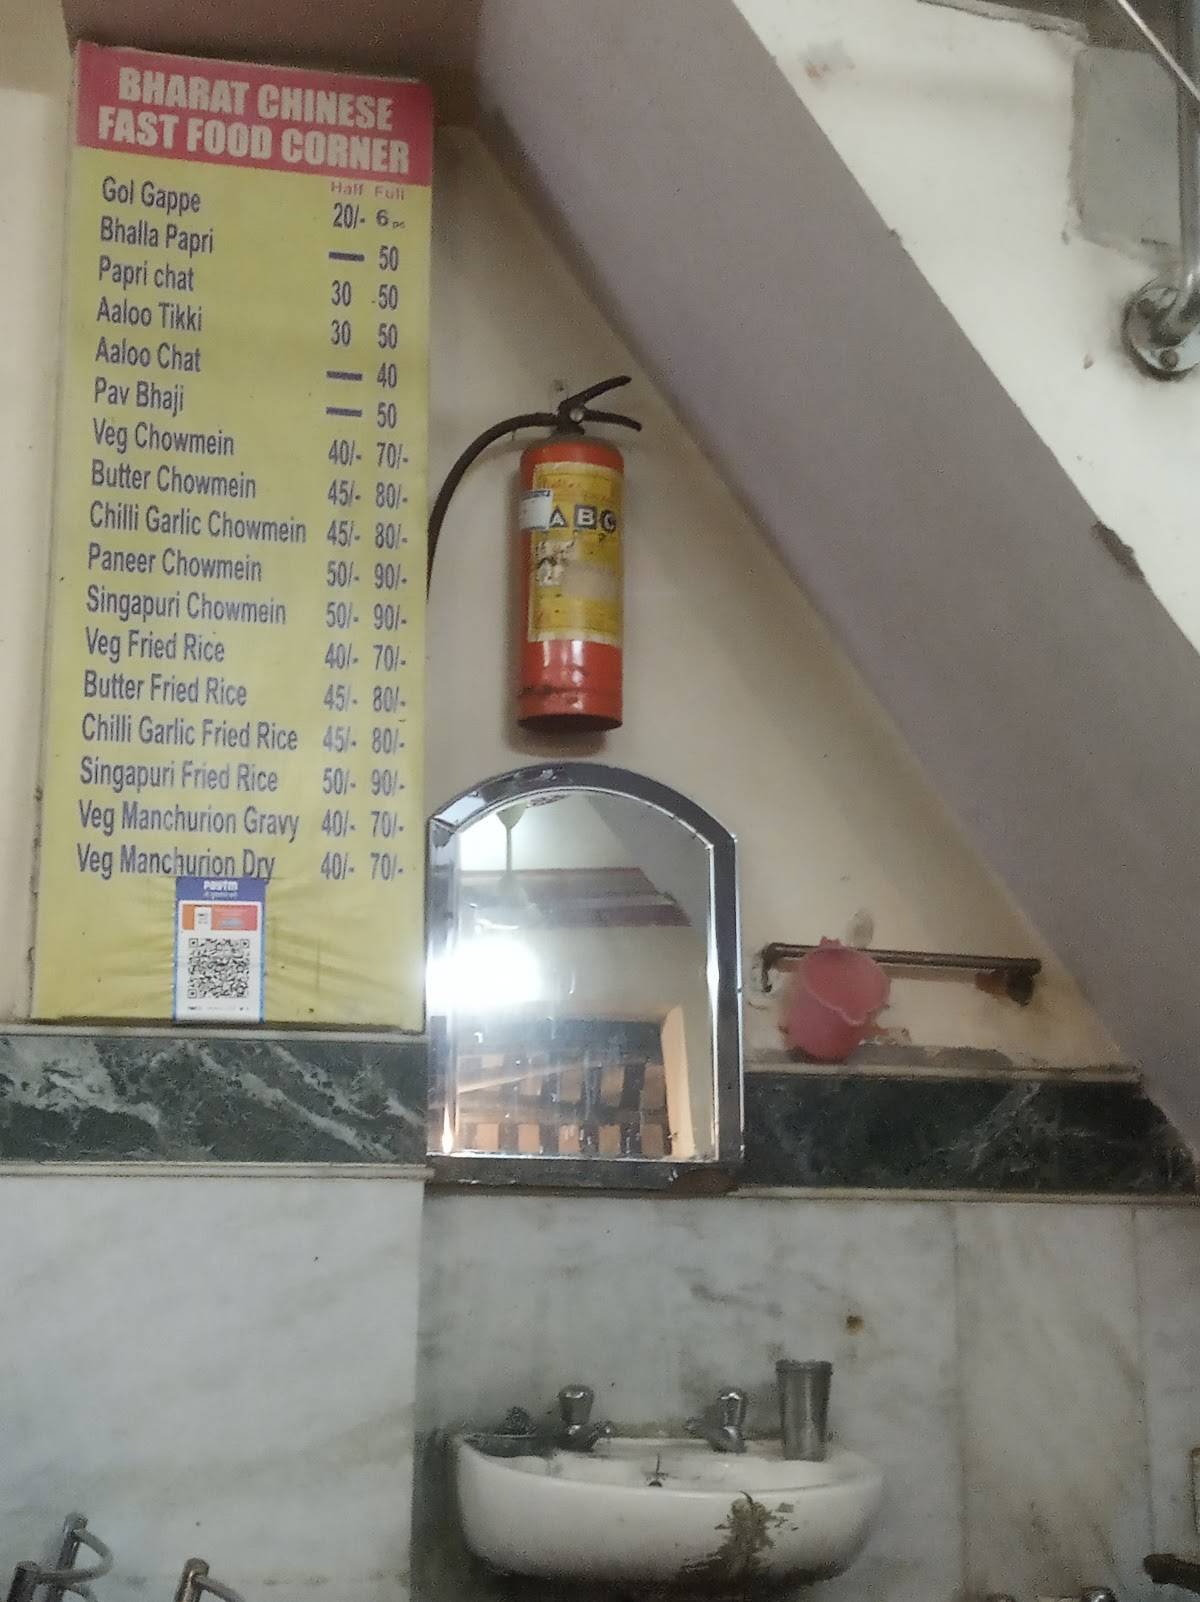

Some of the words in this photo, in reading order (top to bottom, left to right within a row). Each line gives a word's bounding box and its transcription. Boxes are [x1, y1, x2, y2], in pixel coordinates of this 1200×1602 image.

[119, 67, 250, 115] BHARAT
[257, 84, 393, 131] CHINESE
[98, 106, 179, 149] FAST
[186, 118, 273, 160] FOOD
[281, 129, 409, 174] CORNER
[102, 176, 134, 206] Gol
[141, 181, 201, 216] Gappe
[333, 202, 365, 231] 20/-
[100, 216, 159, 248] Bhalla
[165, 224, 213, 259] Papri
[379, 246, 399, 271] 50
[99, 255, 147, 290] Papri
[154, 263, 194, 291] chat
[331, 280, 351, 307] 30
[377, 284, 398, 310] 50
[97, 296, 151, 326] Aaloo
[159, 302, 203, 332] Tikki
[331, 320, 351, 346] 30
[377, 324, 398, 349] 50
[95, 337, 150, 368] Aaloo
[157, 342, 201, 373] Chat
[376, 363, 397, 388] 40
[94, 377, 130, 405] Pav
[136, 380, 184, 417] Bhaji
[377, 402, 396, 428] 50
[93, 418, 128, 454] Veg
[135, 422, 234, 455] Chowmein
[328, 440, 362, 466] 40/-
[376, 443, 409, 469] 70/-
[92, 459, 151, 490] Butter
[157, 465, 256, 499] Chowmein
[327, 480, 361, 507] 45/-
[376, 482, 408, 510] 80/-
[90, 500, 139, 531] Chilli
[146, 505, 201, 537] Garlic
[208, 511, 306, 544] Chowmein
[326, 520, 360, 547] 45/-
[375, 523, 408, 550] 80/-
[88, 543, 155, 573] Paneer
[162, 548, 262, 582] Chowmein
[326, 561, 360, 588] 50/-
[374, 563, 407, 590] 90/-
[87, 583, 180, 622] Singapuri
[187, 592, 286, 625] Chowmein
[326, 602, 359, 629] 50/-
[374, 604, 407, 631] 90/-
[86, 627, 121, 663] Veg
[128, 630, 177, 660] Fried
[184, 634, 225, 663] Rice
[324, 643, 359, 670] 40/-
[373, 644, 407, 672] 70/-
[84, 670, 144, 700] Butter
[150, 673, 199, 703] Fried
[206, 677, 246, 706] Rice
[323, 684, 357, 711] 45/-
[373, 686, 406, 713] 80/-
[82, 712, 132, 743] Chilli
[139, 716, 195, 746] Garlic
[202, 719, 250, 749] Fried
[256, 722, 298, 751] Rice
[323, 726, 357, 753] 45/-
[371, 727, 405, 754] 80/-
[80, 756, 175, 794] Singapuri
[181, 761, 229, 790] Fried
[237, 763, 278, 792] Rice
[322, 767, 356, 795] 50/-
[371, 769, 405, 796] 90/-
[79, 800, 114, 836] Veg
[122, 800, 237, 834] Manchurion
[243, 805, 299, 844] Gravy
[321, 810, 356, 837] 40/-
[370, 811, 404, 838] 70/-
[77, 843, 113, 879] Veg
[120, 845, 236, 877] Manchurion
[242, 849, 275, 884] Dry
[320, 852, 354, 880] 40/-
[370, 853, 404, 881] 70/-
